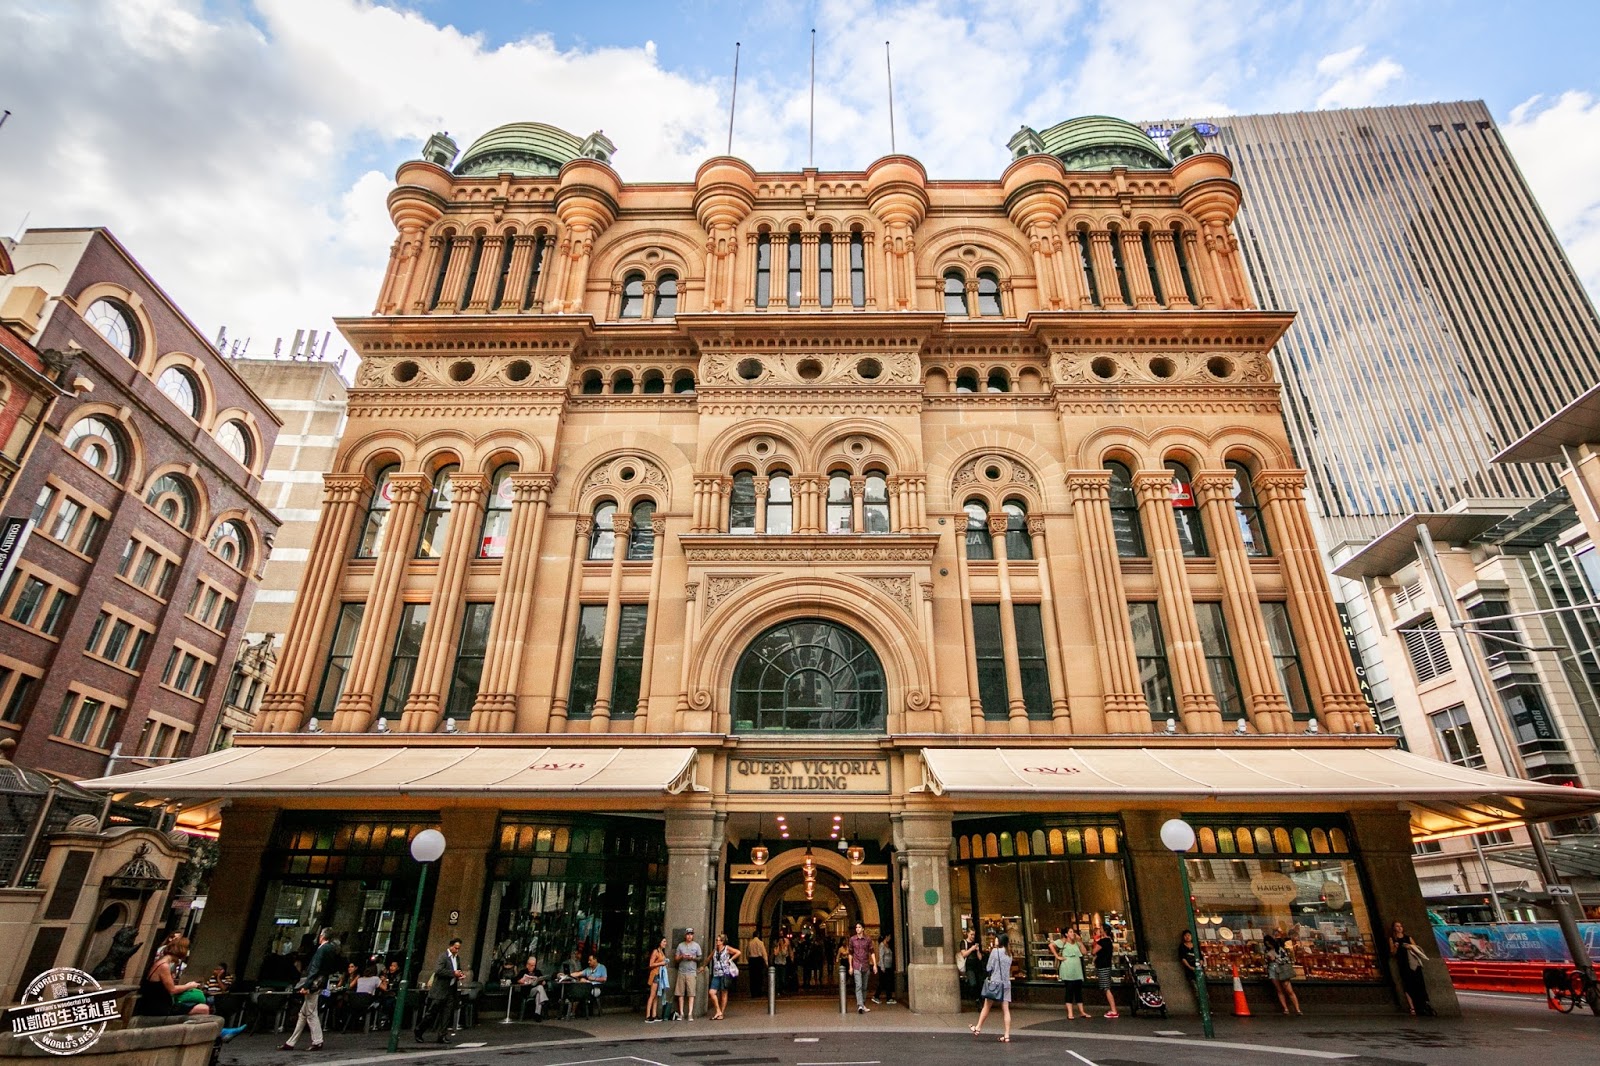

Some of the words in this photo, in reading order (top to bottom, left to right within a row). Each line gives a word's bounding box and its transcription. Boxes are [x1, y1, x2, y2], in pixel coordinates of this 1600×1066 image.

[1340, 613, 1357, 649] THE
[1531, 709, 1550, 737] BOOKS
[737, 760, 793, 776] QUEEN
[802, 760, 880, 775] VICTORIA
[769, 776, 847, 790] BUILDING
